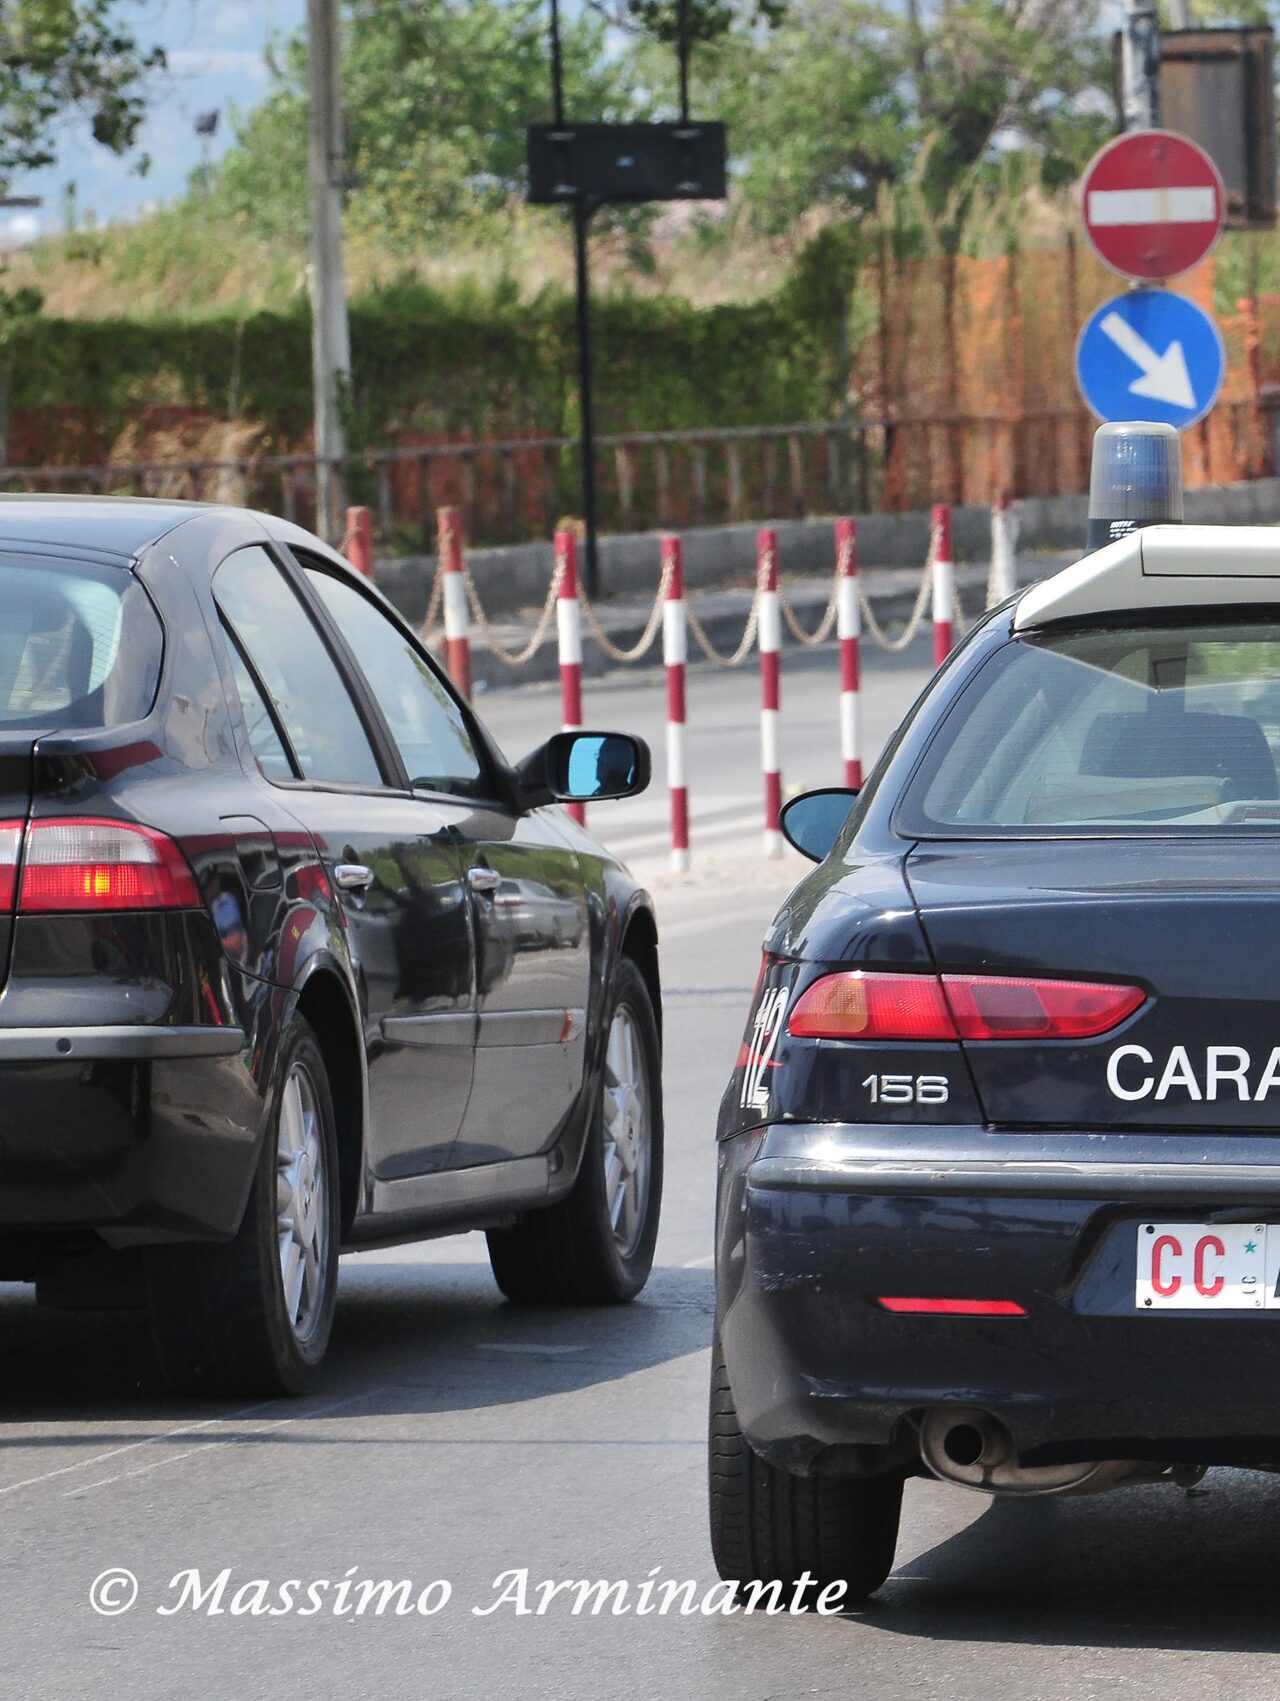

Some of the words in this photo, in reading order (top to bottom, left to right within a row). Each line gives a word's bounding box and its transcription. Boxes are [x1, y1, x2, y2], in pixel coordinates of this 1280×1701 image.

[739, 985, 790, 1113] 112
[861, 1073, 949, 1105] 156
[1150, 1233, 1226, 1299] CC
